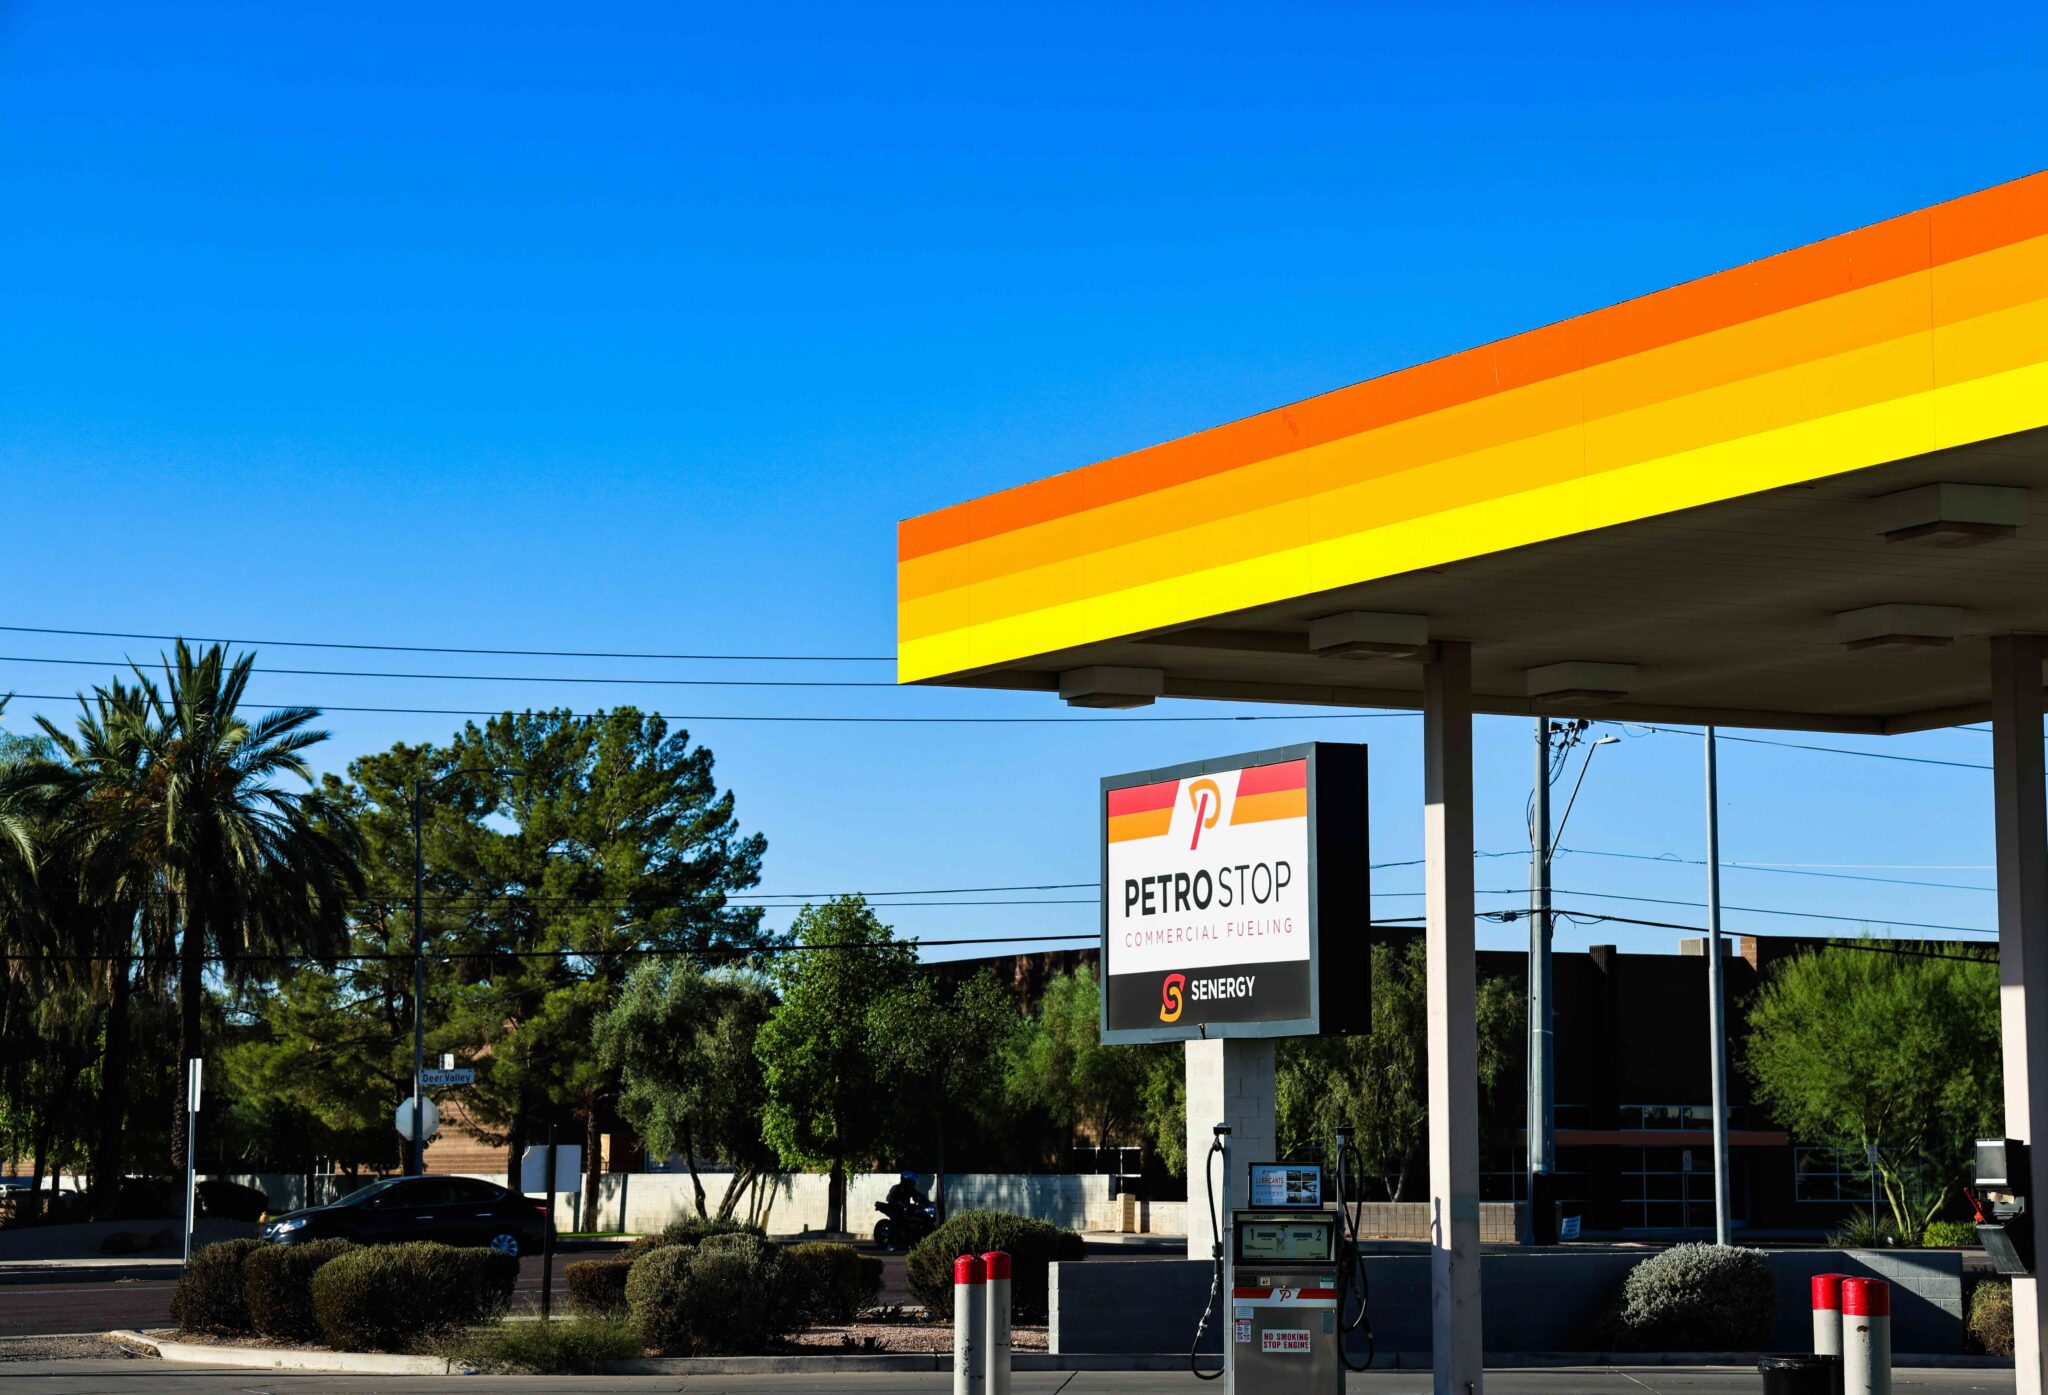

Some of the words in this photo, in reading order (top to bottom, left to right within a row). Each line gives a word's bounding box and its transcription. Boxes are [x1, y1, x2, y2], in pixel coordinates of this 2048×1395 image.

[1125, 924, 1219, 948] COMMERCIAL
[1227, 917, 1293, 938] FUELING
[1191, 976, 1256, 1001] SENERGY
[422, 1074, 442, 1082] Deer
[445, 1073, 471, 1083] Valley
[1316, 1229, 1322, 1241] 2
[1264, 1333, 1274, 1341] NO
[1276, 1333, 1309, 1341] SMOKING
[1263, 1341, 1281, 1349] STOP
